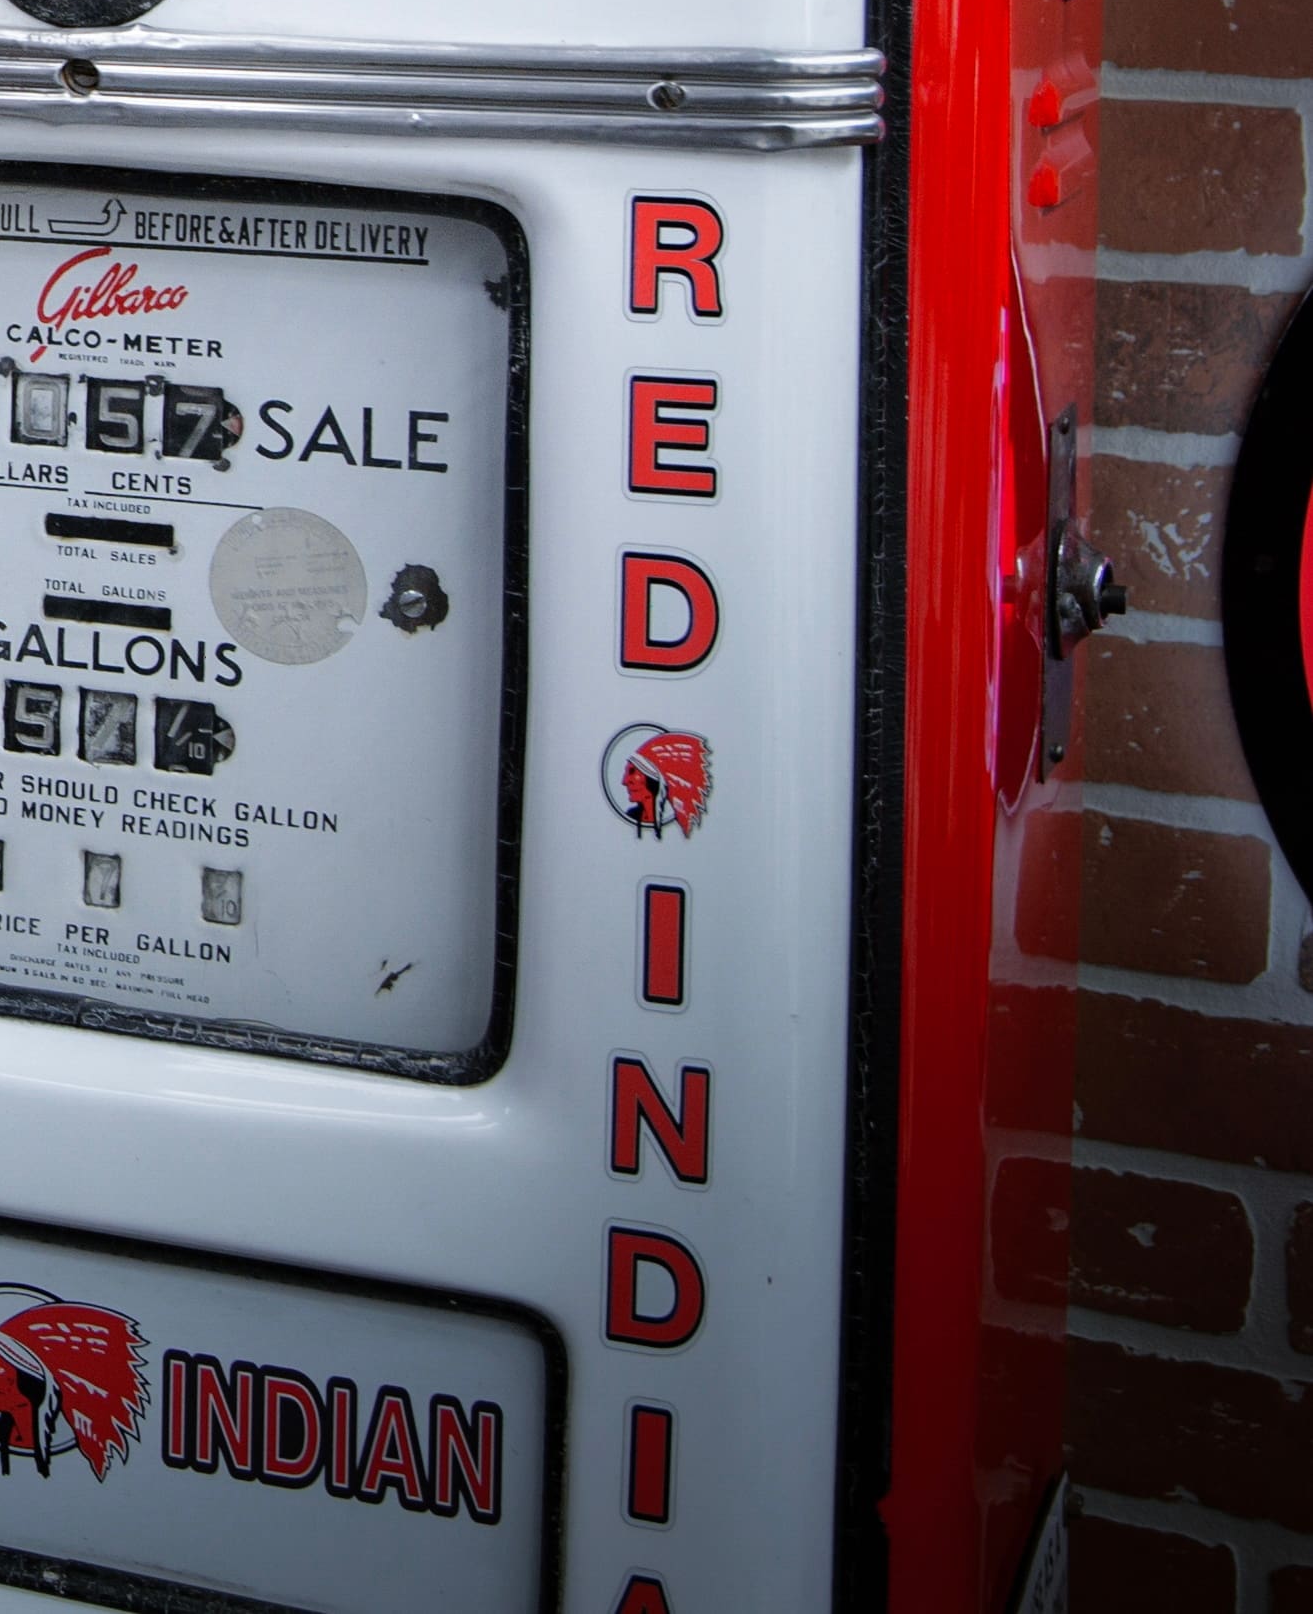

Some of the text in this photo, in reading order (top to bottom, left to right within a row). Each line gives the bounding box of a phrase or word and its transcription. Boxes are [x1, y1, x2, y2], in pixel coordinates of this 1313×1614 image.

[315, 220, 429, 257] DELIVERY
[30, 246, 189, 363] Gilbarco
[6, 324, 224, 358] CALCO-METER
[58, 353, 109, 364] REGISTERED
[255, 399, 450, 473] SALE
[620, 195, 723, 673] RED
[112, 471, 192, 496] CENTS
[67, 497, 151, 515] TAX INCLUDED
[57, 545, 157, 565] TOTAL SALES
[45, 578, 167, 602] TOTAL GALLONS
[21, 775, 118, 804] SHOULD
[133, 789, 217, 818] CHECK
[235, 802, 338, 833] GALLON
[22, 801, 105, 829] MONEY
[122, 814, 250, 848] READINGS
[9, 953, 56, 966] DISCHARGE
[57, 942, 141, 964] TAX INCLUDED
[65, 923, 110, 946] PER
[136, 933, 231, 963] GALLON
[186, 994, 210, 1004] HEAD
[162, 1349, 504, 1525] INDIAN
